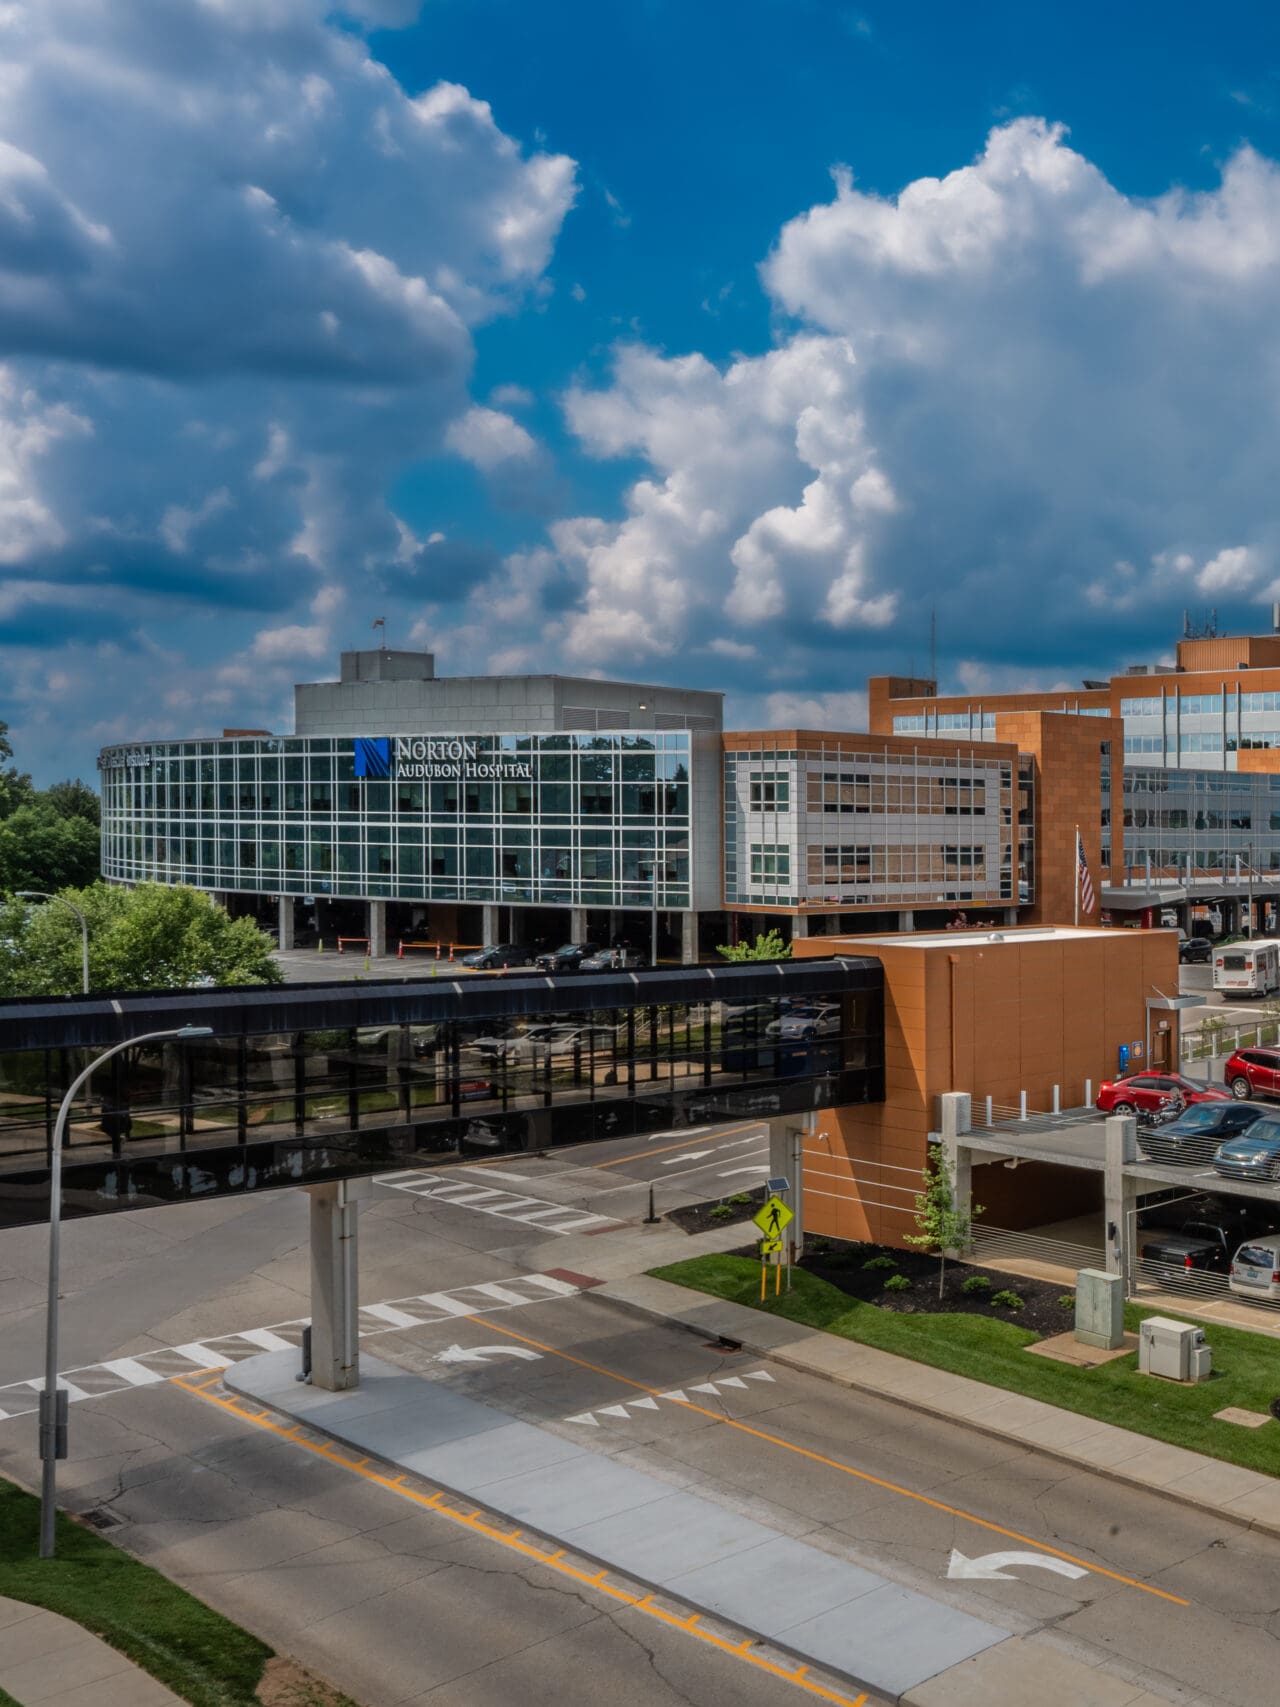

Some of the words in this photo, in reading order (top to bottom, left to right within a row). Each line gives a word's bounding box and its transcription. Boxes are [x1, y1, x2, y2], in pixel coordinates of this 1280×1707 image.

[397, 737, 477, 760] NORTON
[397, 763, 461, 777] AUDUBON
[465, 762, 532, 778] HOSPITAL
